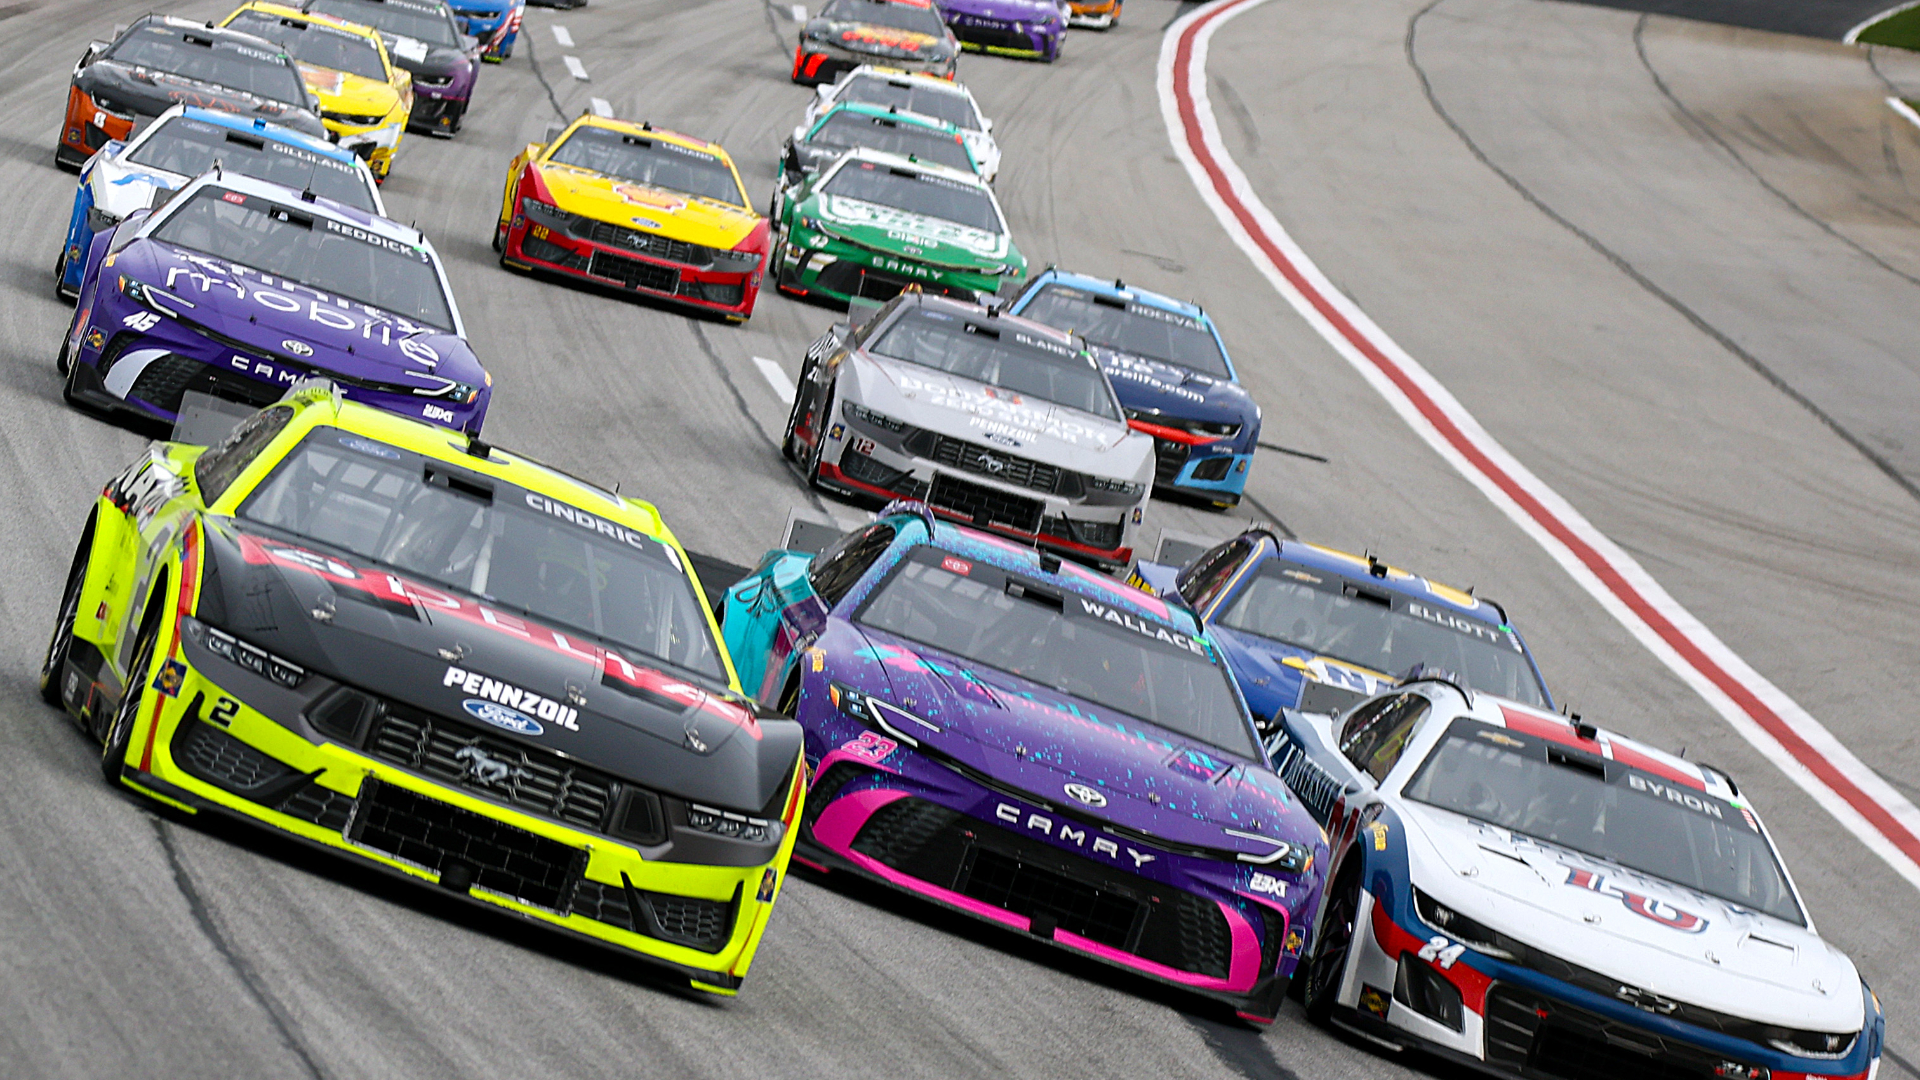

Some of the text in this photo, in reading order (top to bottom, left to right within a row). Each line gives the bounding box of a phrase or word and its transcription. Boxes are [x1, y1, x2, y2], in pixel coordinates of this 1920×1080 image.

[237, 46, 286, 66] BUSCH
[93, 111, 107, 128] 8
[271, 143, 356, 174] GILLILAND
[662, 142, 715, 162] LOGANO
[326, 219, 414, 257] REDDICK
[533, 223, 549, 240] 22
[808, 235, 830, 248] 42
[872, 256, 944, 280] CAMRY
[122, 310, 161, 332] 45
[165, 265, 440, 368] mobile
[1015, 333, 1078, 360] BLANEY
[969, 416, 1038, 444] PENNZOIL
[853, 437, 876, 456] 12
[525, 492, 644, 549] CINDRIC
[1080, 598, 1205, 657] WALLACE
[1408, 602, 1501, 643] ELLIOTT
[208, 697, 240, 728] 2
[442, 665, 580, 732] PENNZOIL
[841, 729, 899, 764] 23
[1628, 773, 1723, 820] BYRON
[995, 802, 1156, 868] CAMRY
[1418, 935, 1467, 970] 24
